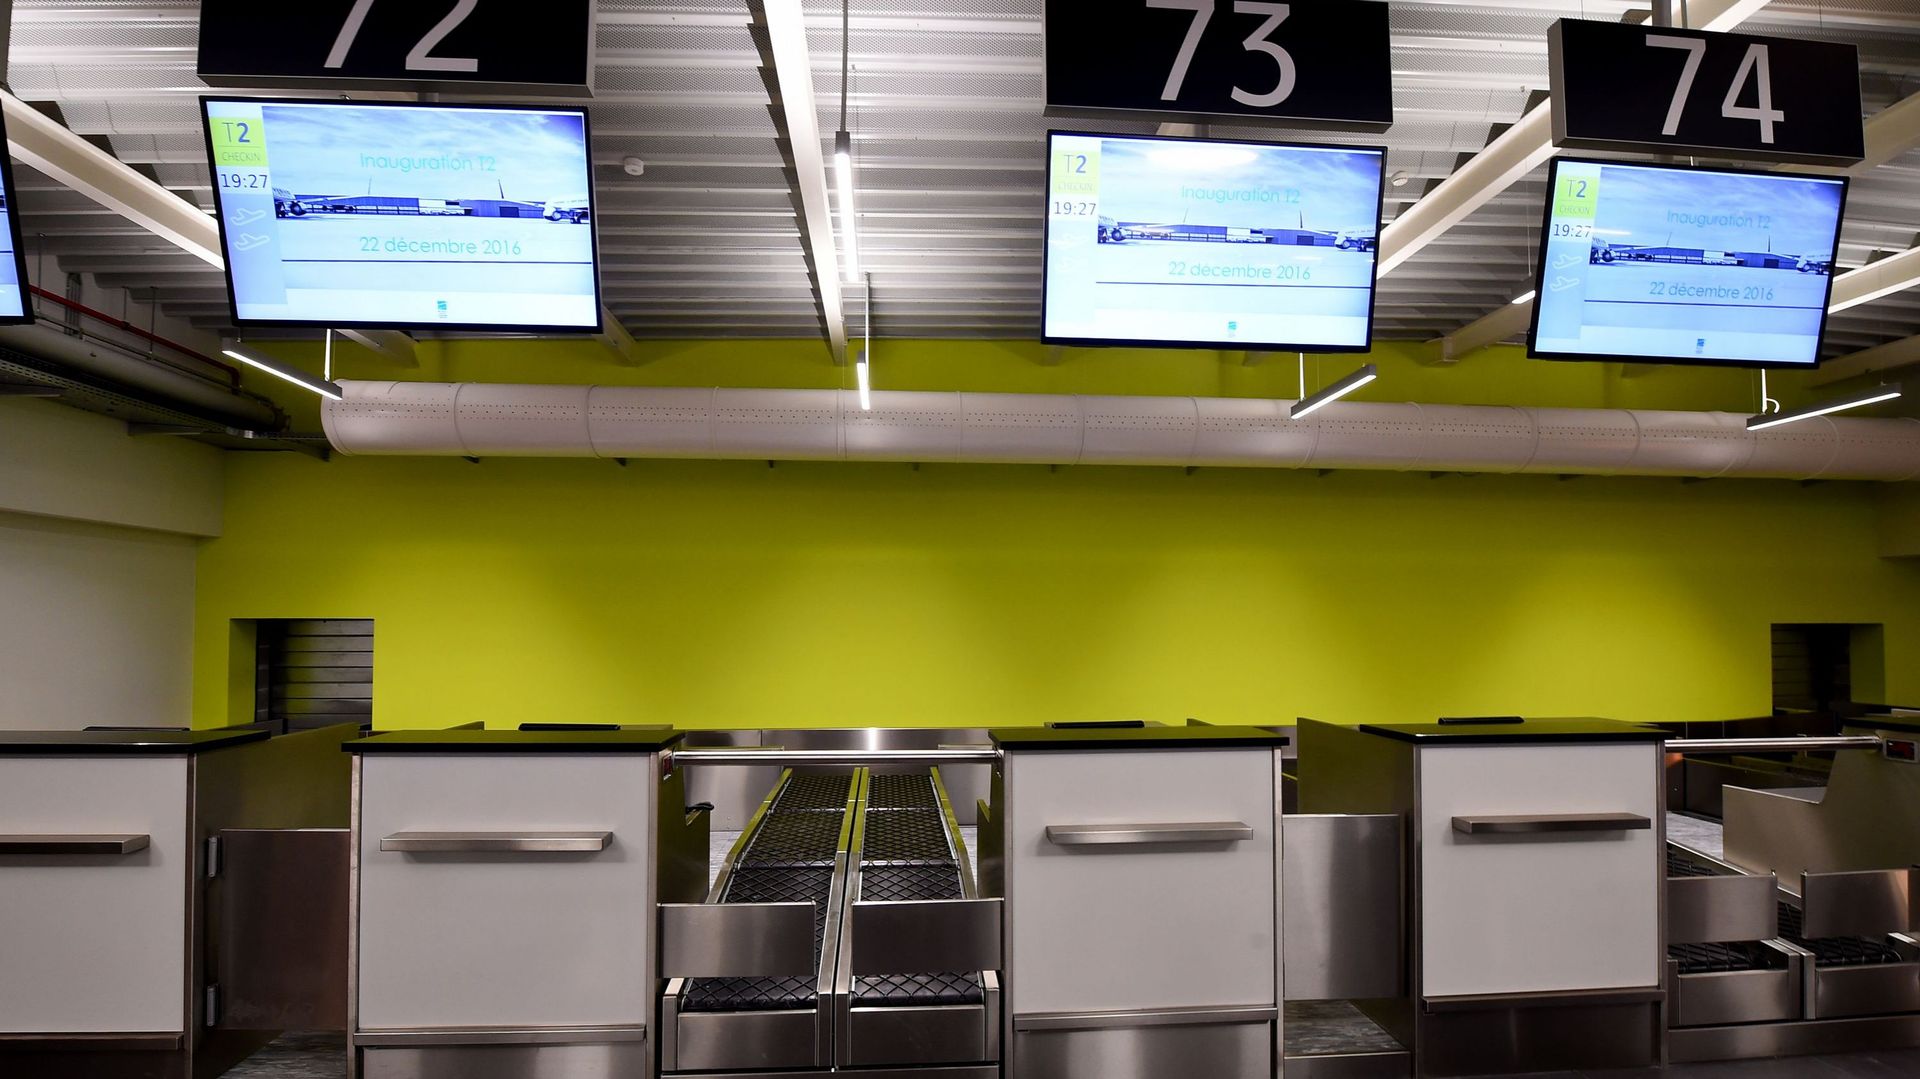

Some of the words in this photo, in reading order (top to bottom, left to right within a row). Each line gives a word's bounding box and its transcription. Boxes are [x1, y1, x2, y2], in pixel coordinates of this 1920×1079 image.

[1145, 0, 1297, 107] 73
[1645, 33, 1784, 144] 74
[221, 122, 251, 143] T2
[359, 152, 473, 173] Inauguration
[1063, 154, 1087, 174] T2
[220, 173, 268, 189] 19:27
[1567, 179, 1587, 198] T2
[1181, 185, 1280, 204] Inauguration
[1054, 201, 1097, 216] 19:27
[1666, 208, 1753, 228] Inauguration
[1553, 223, 1592, 238] 19:27
[359, 236, 381, 252] 22
[384, 237, 478, 255] décembre
[482, 239, 522, 256] 2016
[1168, 261, 1187, 276] 22
[1276, 264, 1312, 281] 2016
[1649, 281, 1666, 296] 22
[1743, 286, 1775, 302] 2016
